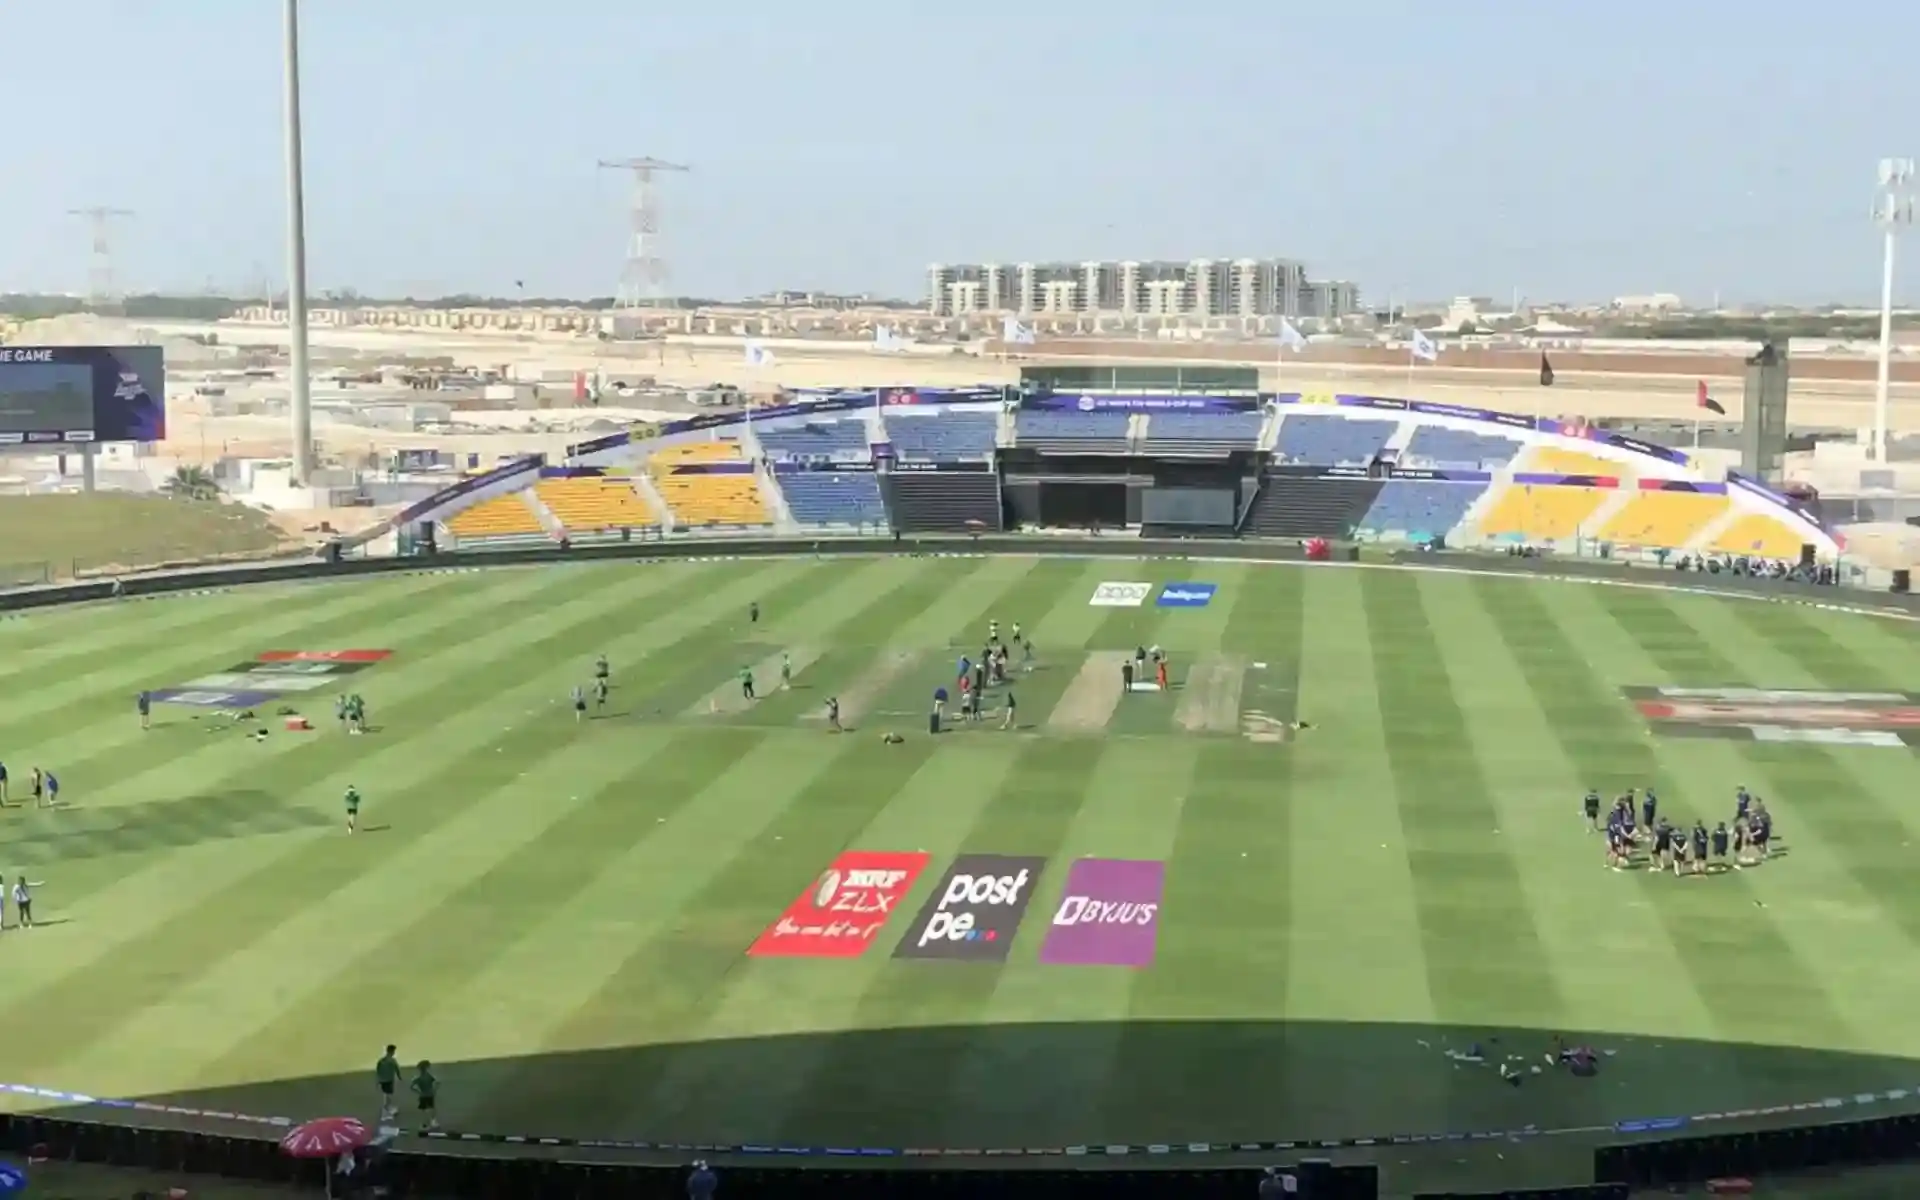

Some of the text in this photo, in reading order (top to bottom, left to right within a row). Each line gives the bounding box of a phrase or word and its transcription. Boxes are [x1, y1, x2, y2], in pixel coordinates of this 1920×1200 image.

[14, 349, 53, 362] GAME
[830, 891, 894, 912] ZLX
[937, 868, 1029, 911] post
[1080, 900, 1158, 925] BYJU'S
[917, 911, 975, 947] pe
